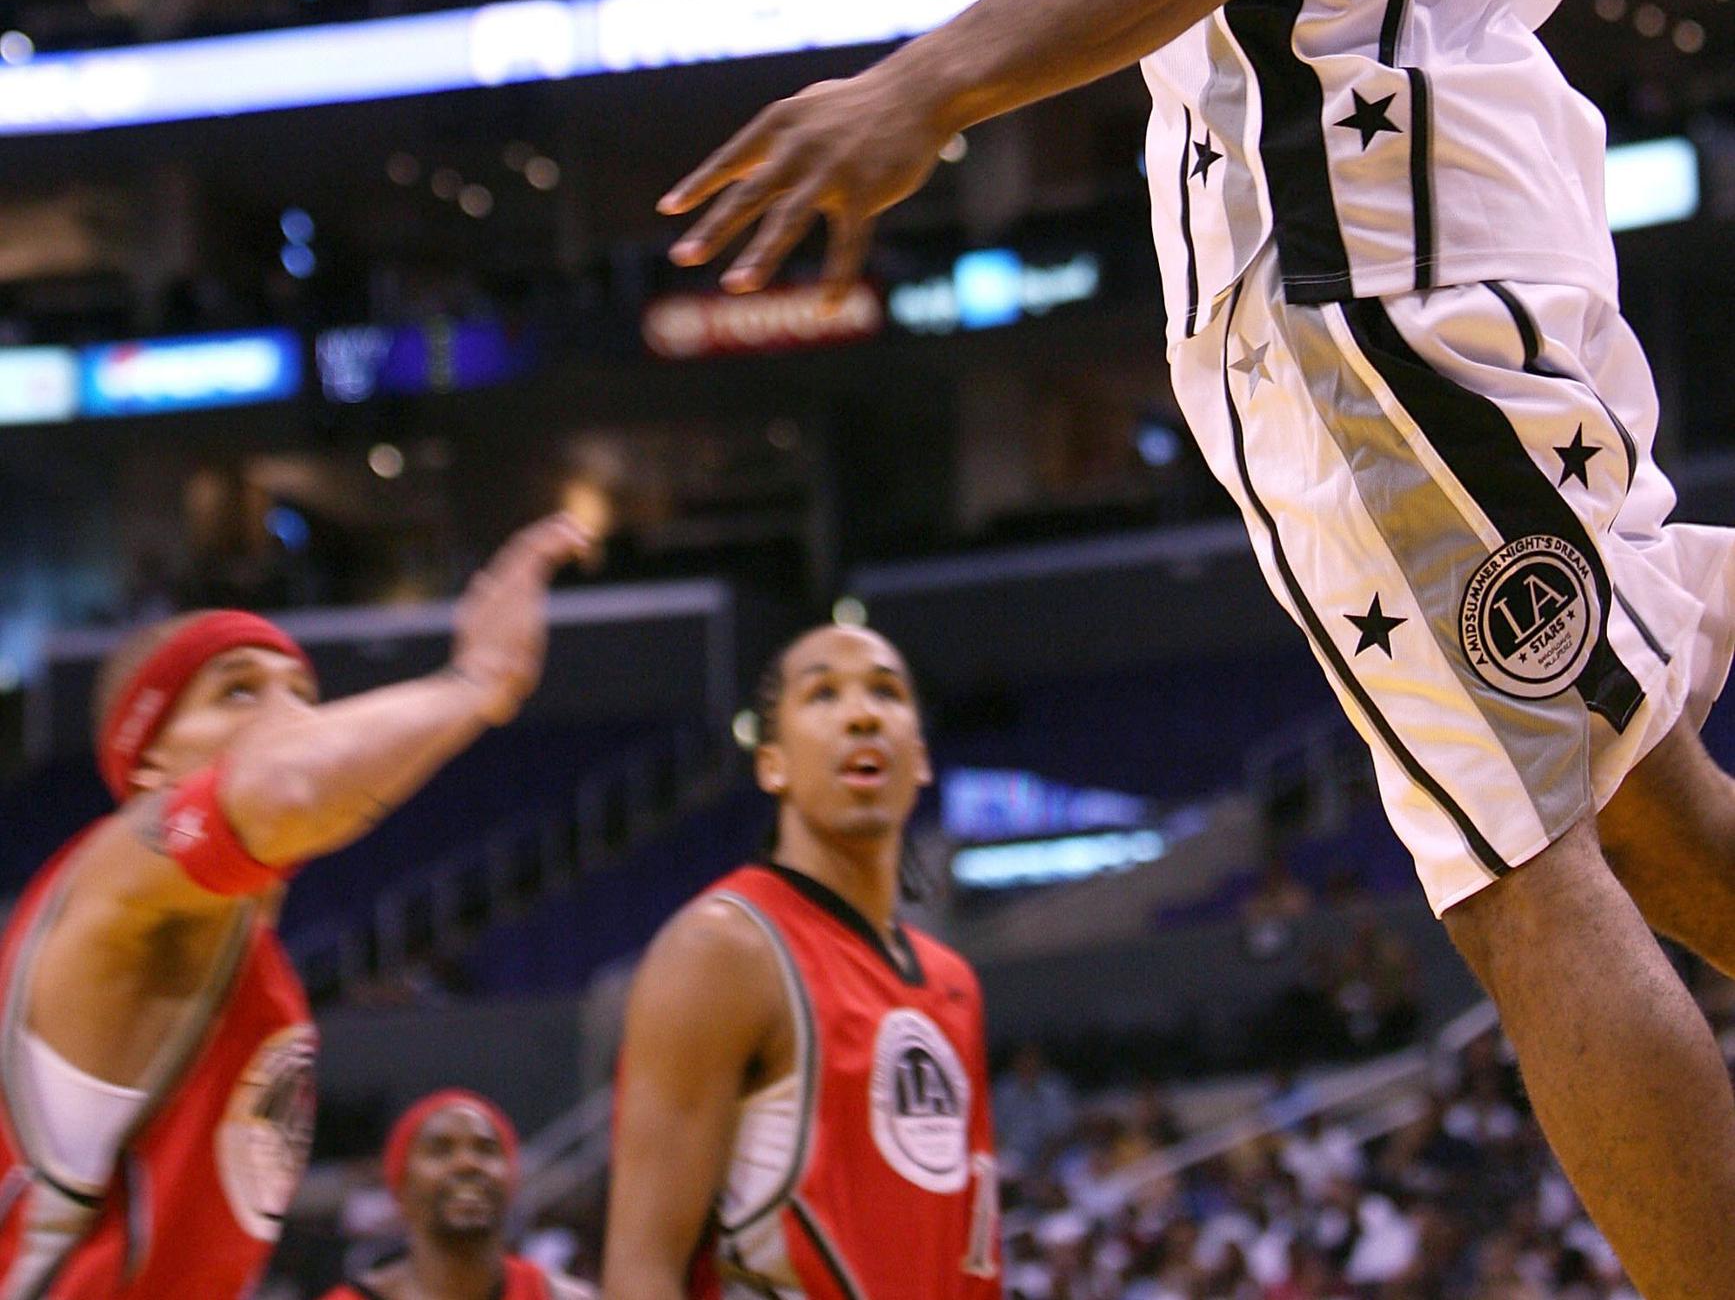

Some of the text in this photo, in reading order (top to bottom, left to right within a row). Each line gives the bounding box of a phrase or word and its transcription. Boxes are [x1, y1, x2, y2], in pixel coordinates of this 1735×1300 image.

[1465, 537, 1589, 666] A MIDSUMMER NIGHT'S DREAM
[1493, 574, 1568, 644] LA
[1529, 617, 1566, 654] STARS
